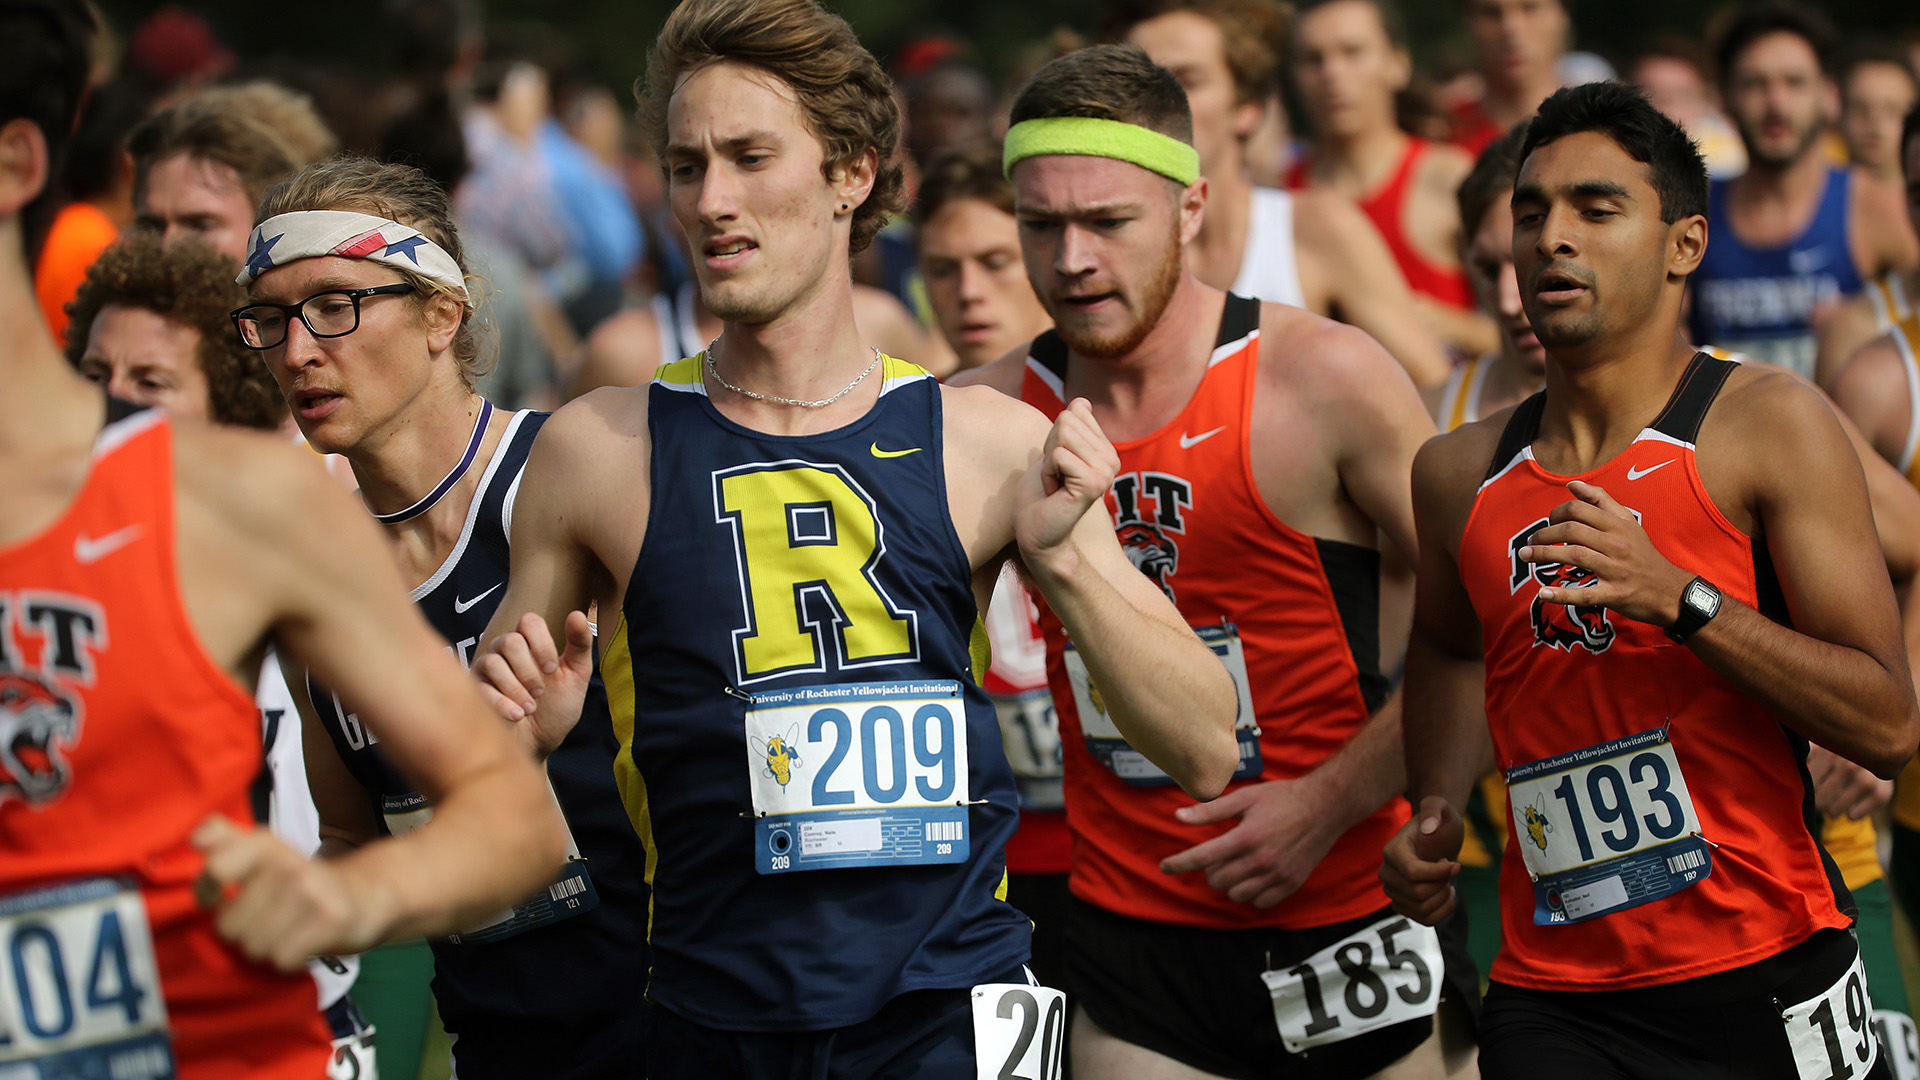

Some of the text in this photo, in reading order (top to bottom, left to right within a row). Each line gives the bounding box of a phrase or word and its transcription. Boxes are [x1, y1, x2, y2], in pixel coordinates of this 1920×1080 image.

[1102, 471, 1194, 535] IT
[711, 459, 921, 686] R
[795, 690, 805, 699] of
[806, 688, 851, 699] Rochester
[852, 685, 908, 696] Yellowjacket
[910, 683, 958, 694] Invitational
[807, 704, 956, 806] 209
[1535, 763, 1542, 771] of
[1541, 756, 1574, 769] Rochester
[1573, 743, 1619, 760] Yellowjacket
[1620, 730, 1664, 749] Invitational
[1554, 752, 1685, 862] 193
[771, 855, 790, 870] 209
[936, 843, 952, 855] 209
[1683, 870, 1698, 882] 193
[565, 897, 581, 910] 121
[1550, 911, 1566, 922] 193
[0, 909, 146, 1046] 04
[1288, 918, 1432, 1037] 185
[1808, 960, 1876, 1080] 19
